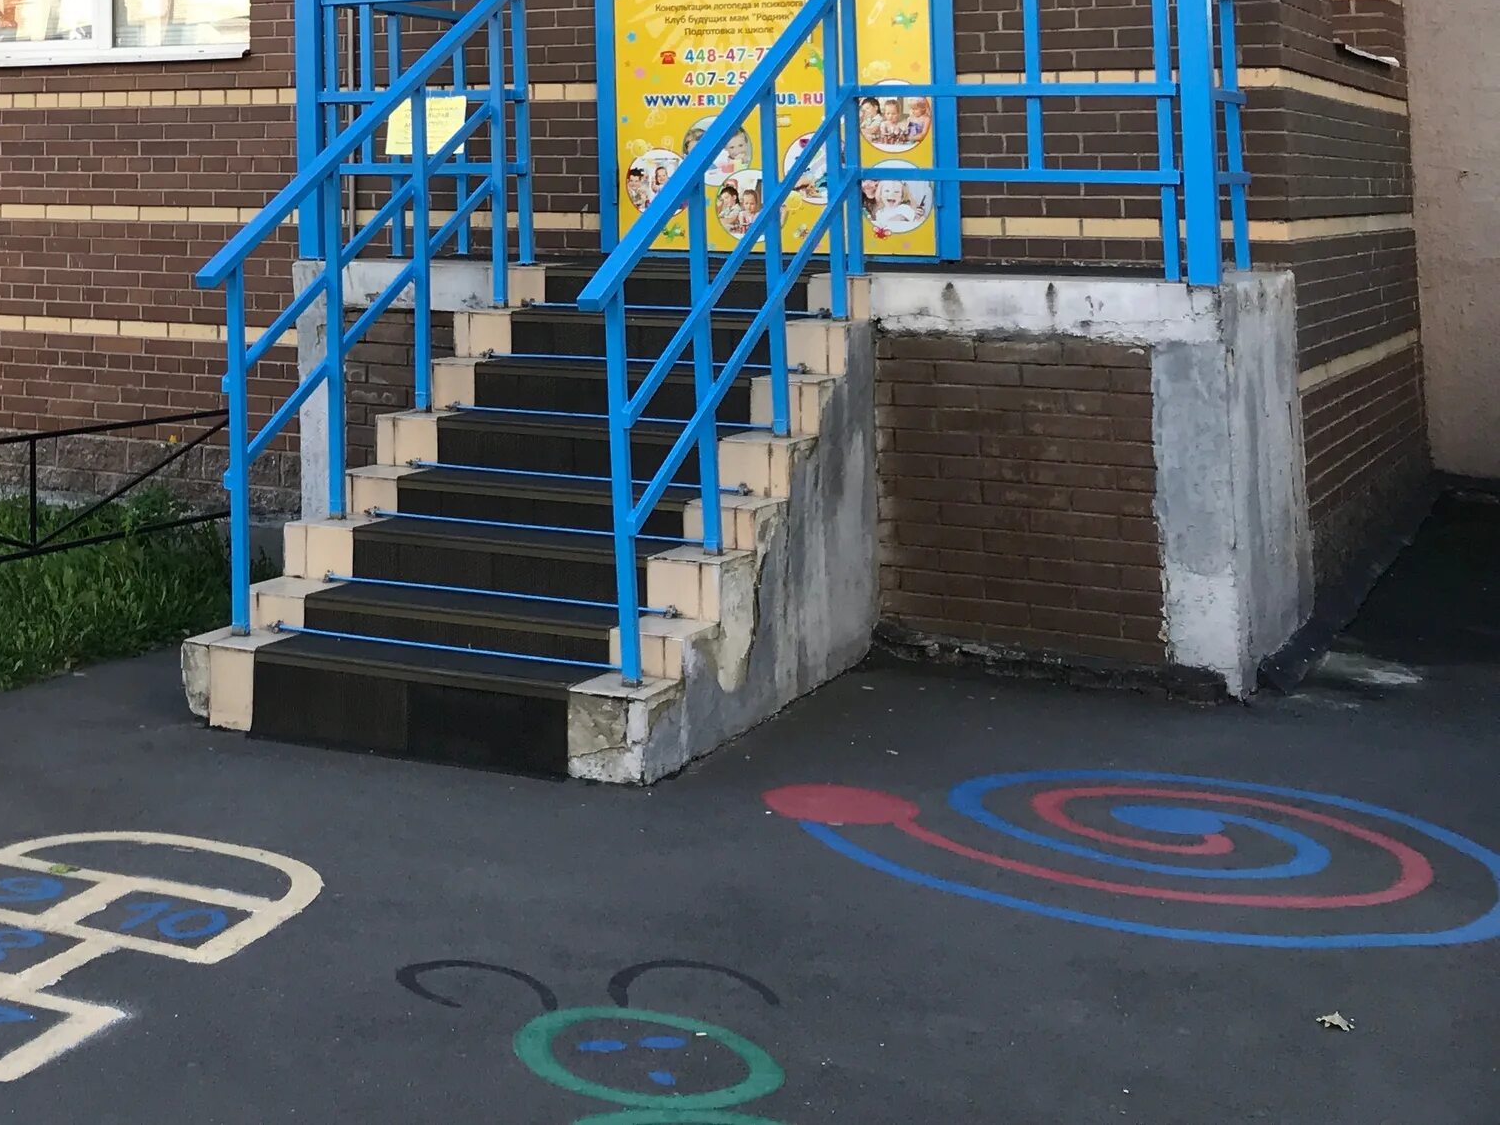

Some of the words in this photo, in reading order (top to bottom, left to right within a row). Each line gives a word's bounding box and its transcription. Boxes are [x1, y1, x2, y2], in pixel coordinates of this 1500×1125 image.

[655, 3, 711, 13] Консультации
[713, 2, 752, 11] логопеда
[761, 0, 803, 9] психолога
[664, 15, 686, 25] Клуб
[688, 14, 727, 25] будущих
[729, 14, 749, 22] мам
[684, 27, 736, 37] Подготовка
[744, 26, 774, 35] школе
[684, 47, 771, 63] 448-47-7
[684, 71, 747, 87] 407-25
[119, 900, 229, 940] 10
